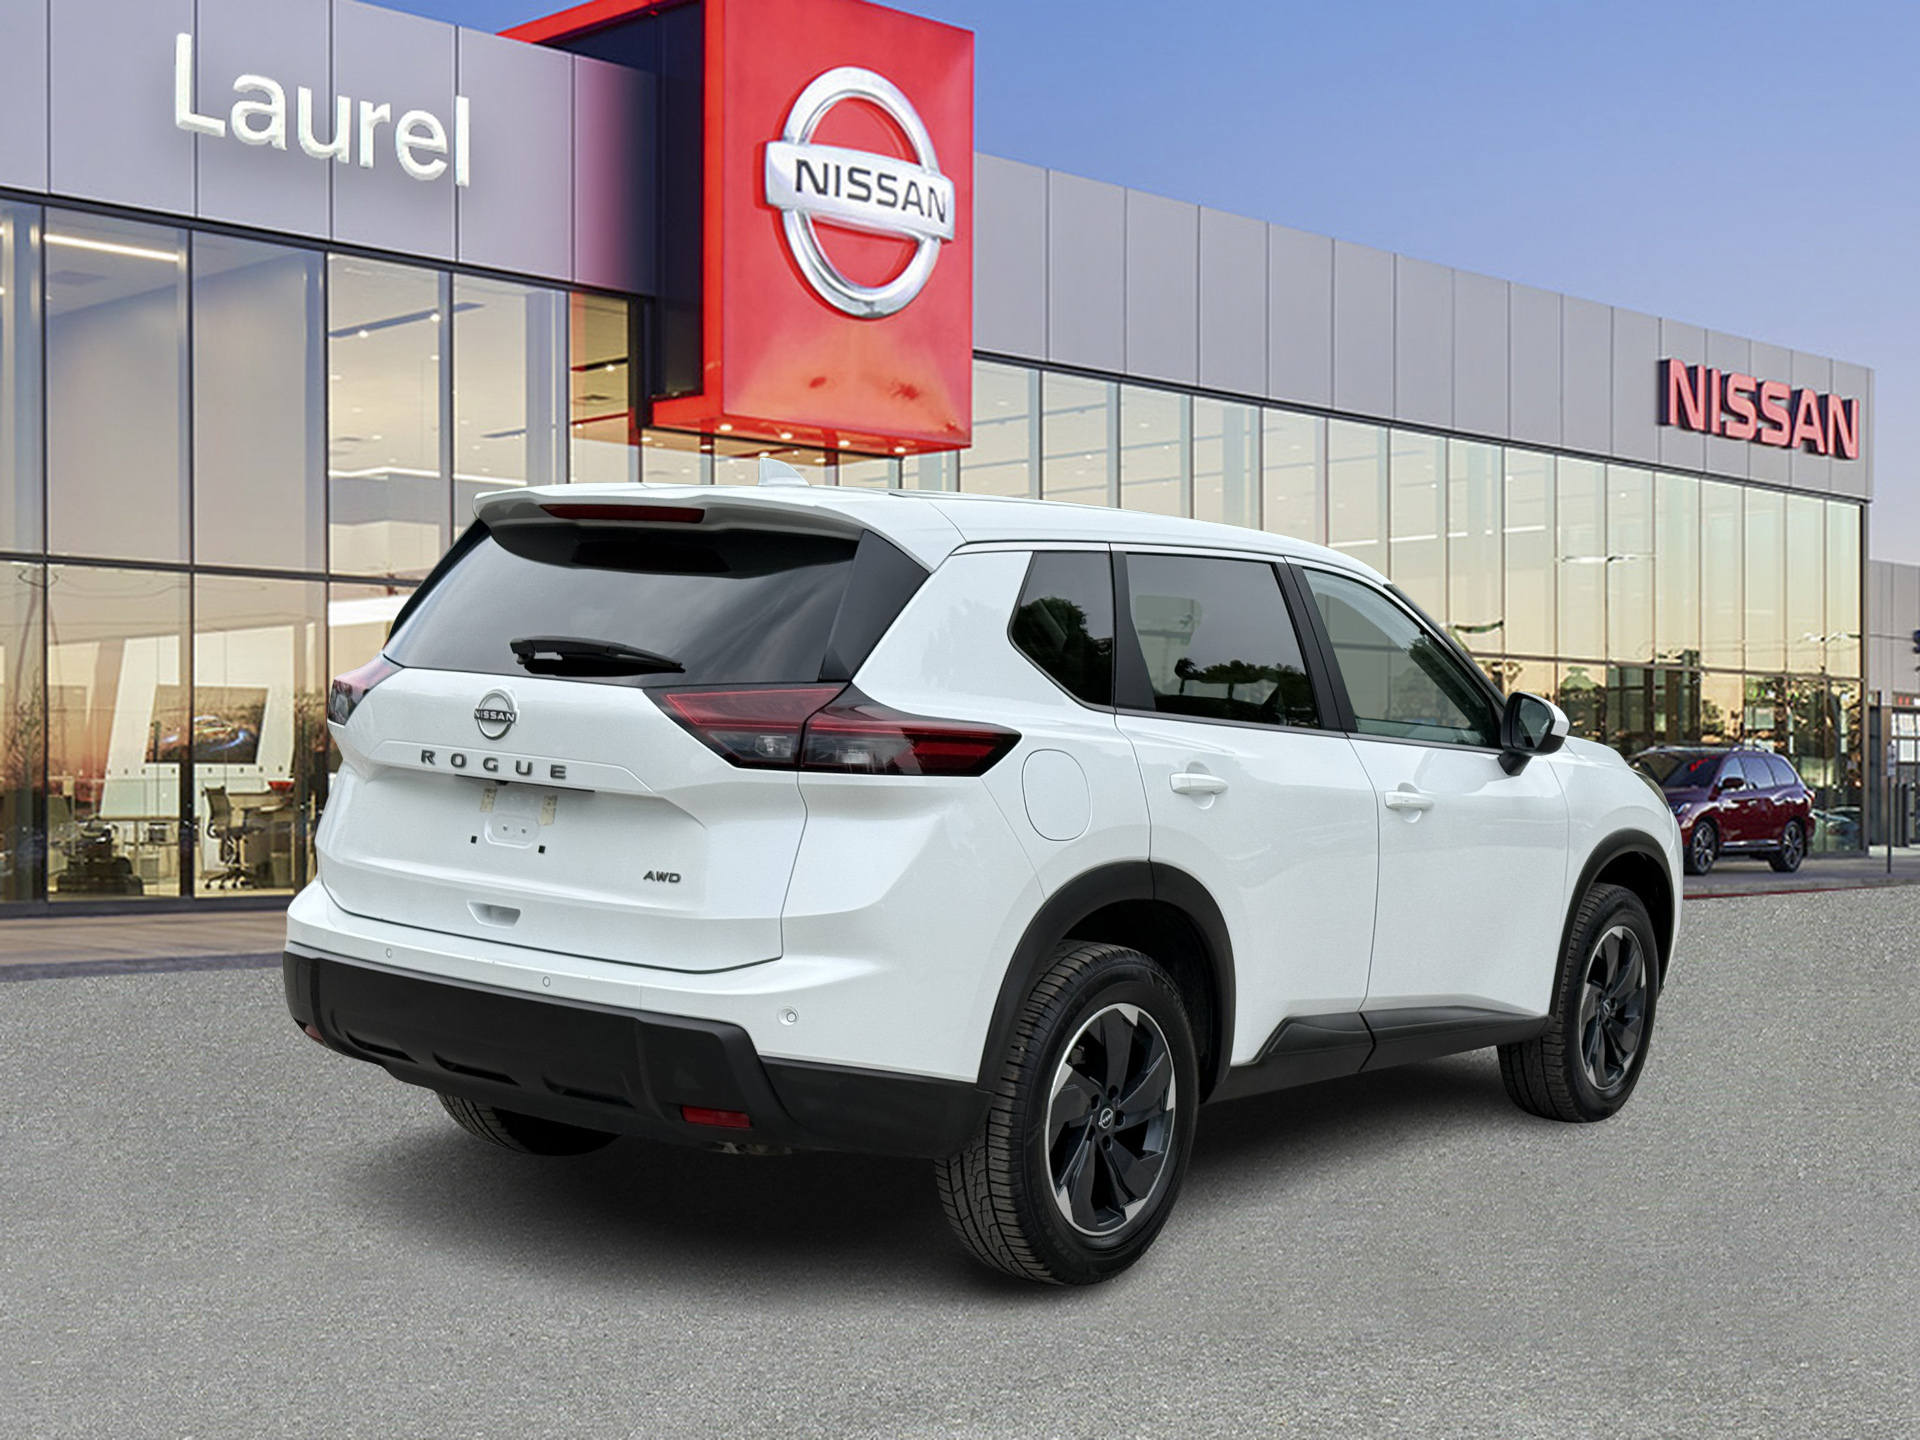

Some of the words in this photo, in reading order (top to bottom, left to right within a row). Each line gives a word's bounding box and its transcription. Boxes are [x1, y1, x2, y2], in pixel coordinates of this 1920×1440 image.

[175, 32, 470, 187] Laurel
[795, 158, 946, 224] NISSAN
[1658, 358, 1860, 460] NISSAN
[474, 709, 515, 722] NISSAN
[420, 749, 567, 780] ROGUE
[642, 870, 682, 883] AWD
